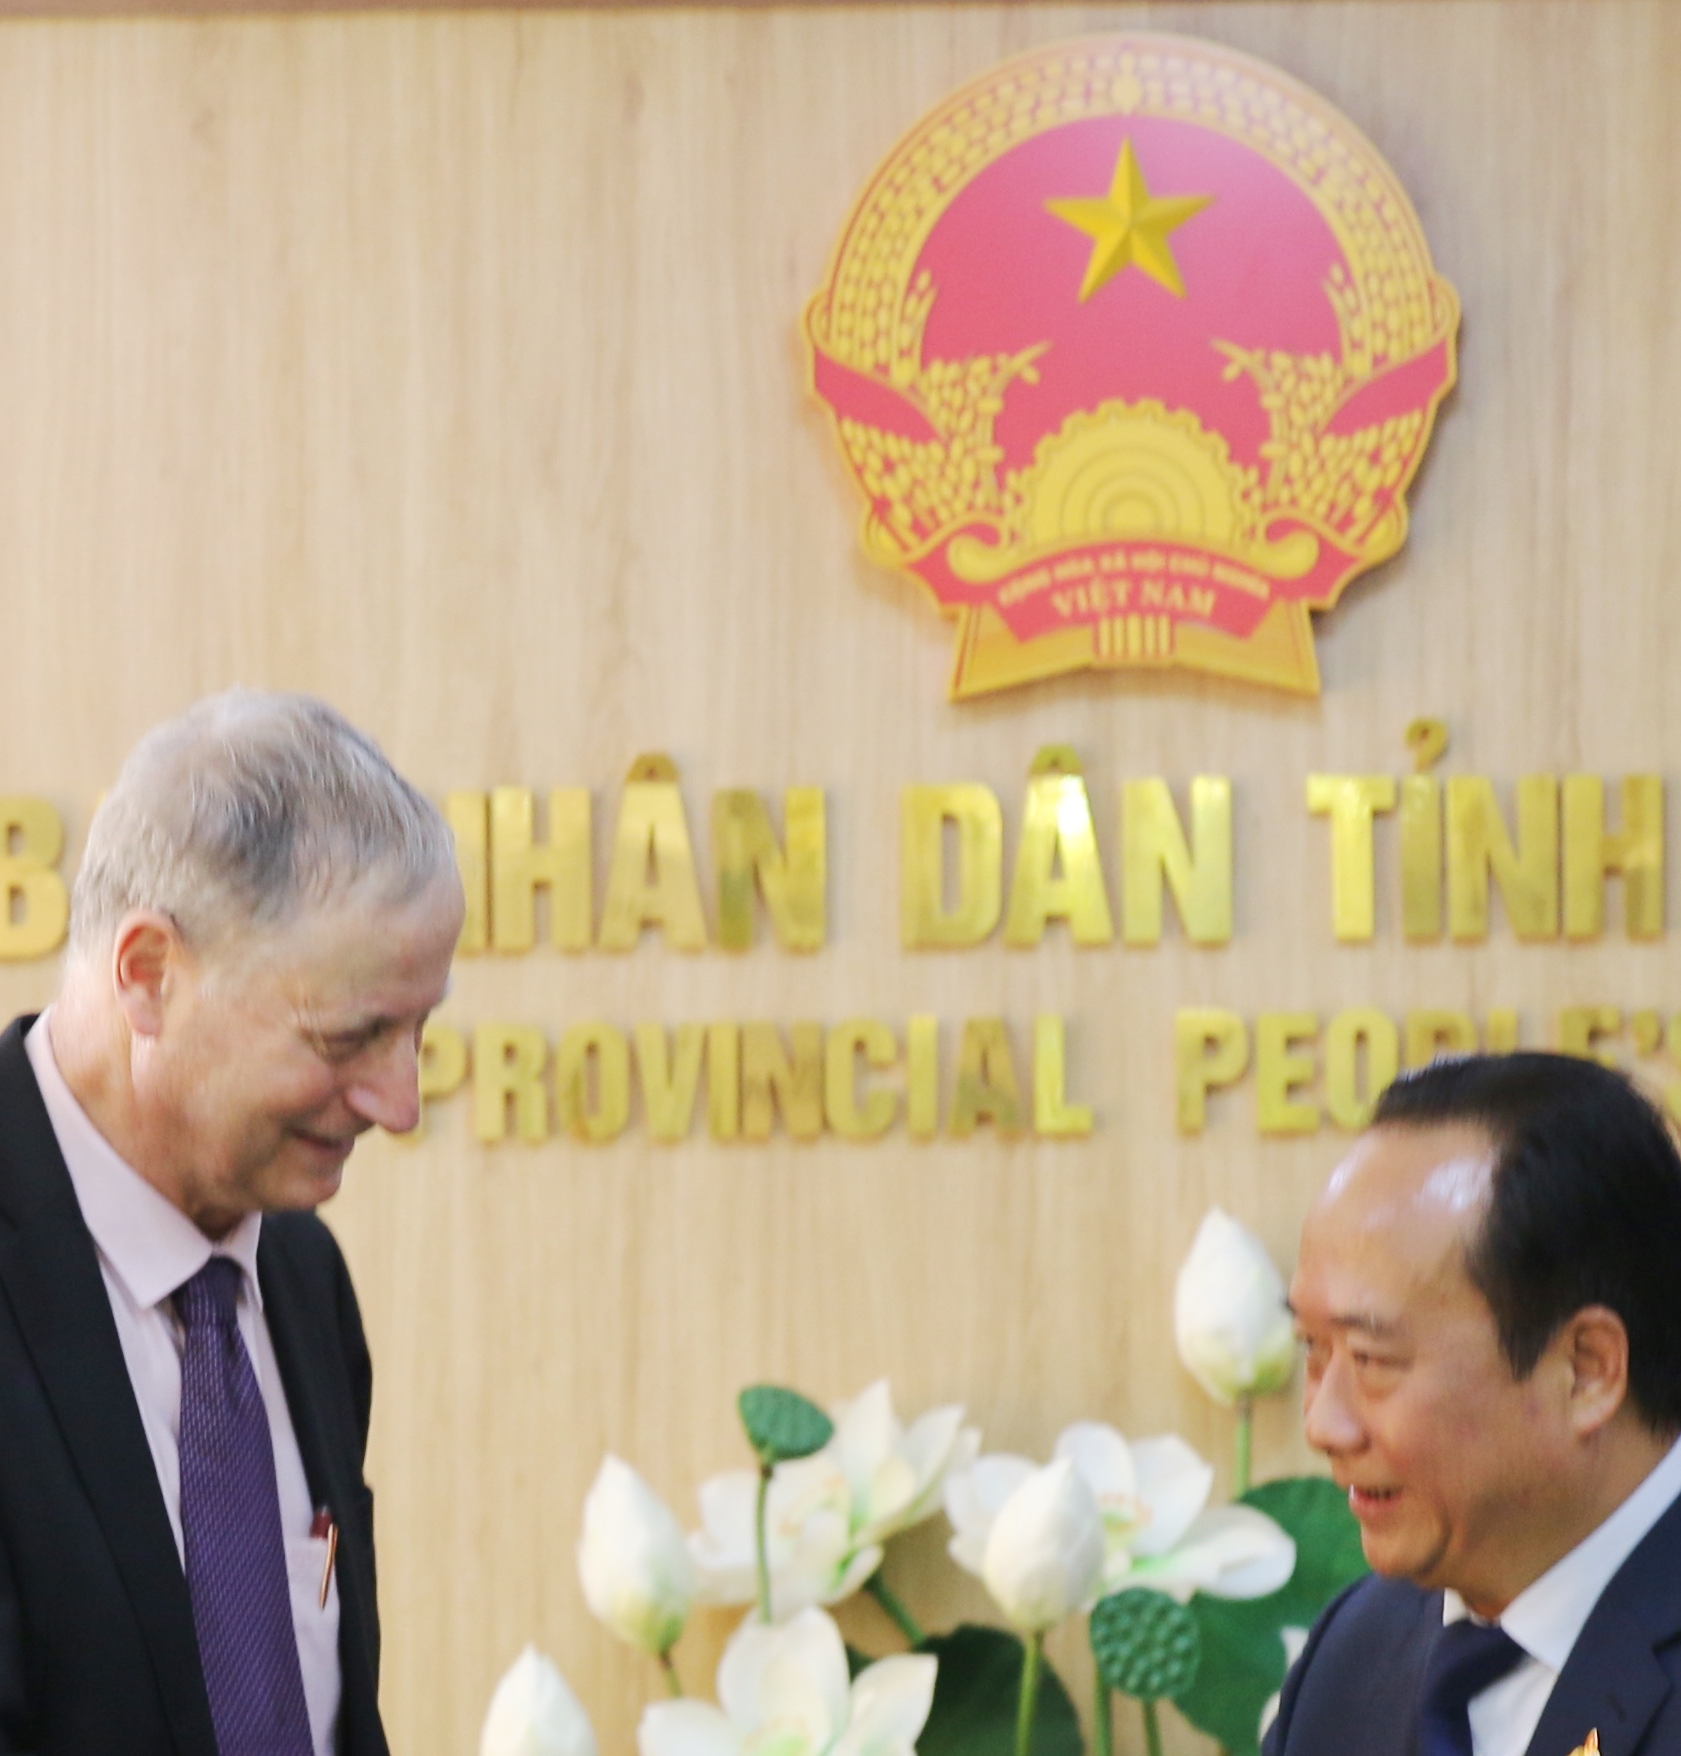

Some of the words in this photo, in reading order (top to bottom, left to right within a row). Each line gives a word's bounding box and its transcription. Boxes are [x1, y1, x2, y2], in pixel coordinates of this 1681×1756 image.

[1142, 579, 1216, 617] NAM
[901, 744, 1233, 949] DÂN
[1307, 717, 1665, 943] TỈNH
